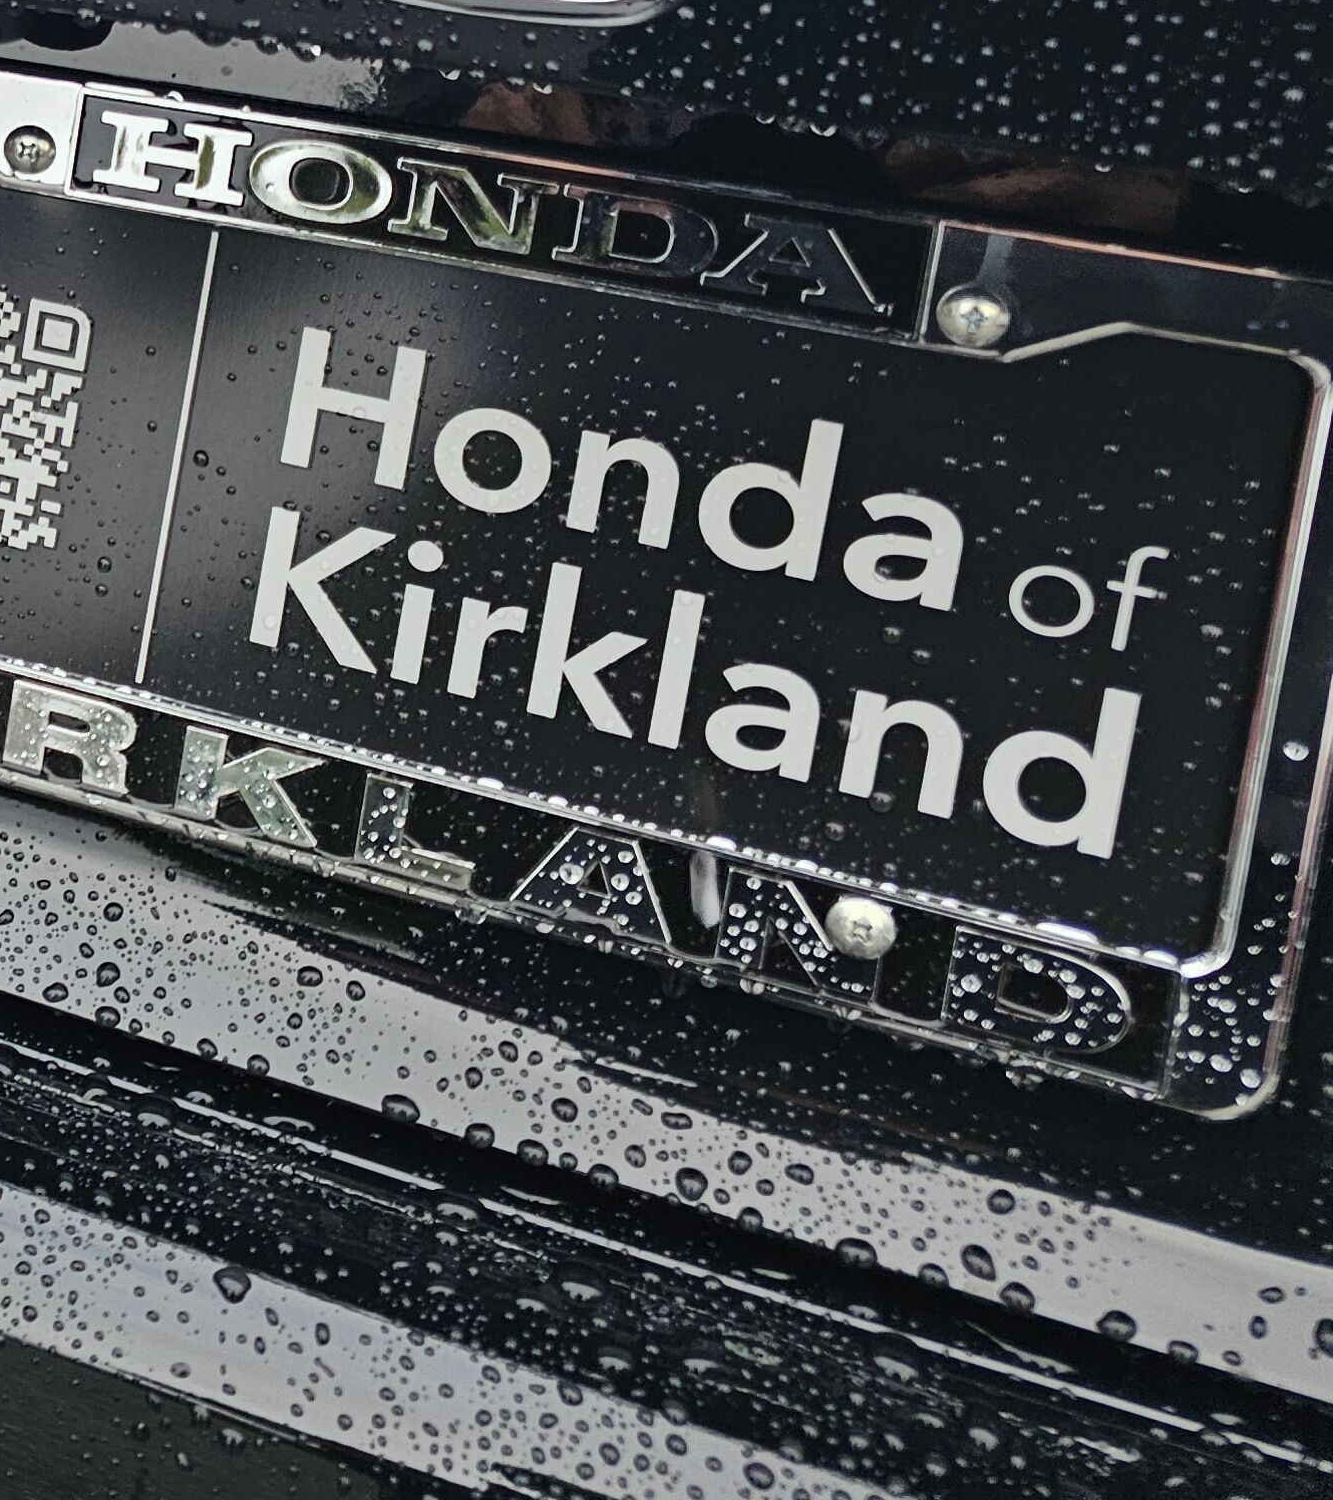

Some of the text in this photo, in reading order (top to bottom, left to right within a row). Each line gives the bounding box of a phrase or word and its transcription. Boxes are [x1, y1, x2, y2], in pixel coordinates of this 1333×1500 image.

[93, 109, 895, 317] HONDA
[278, 326, 1170, 652] Honda of
[249, 506, 1141, 860] Kirkland
